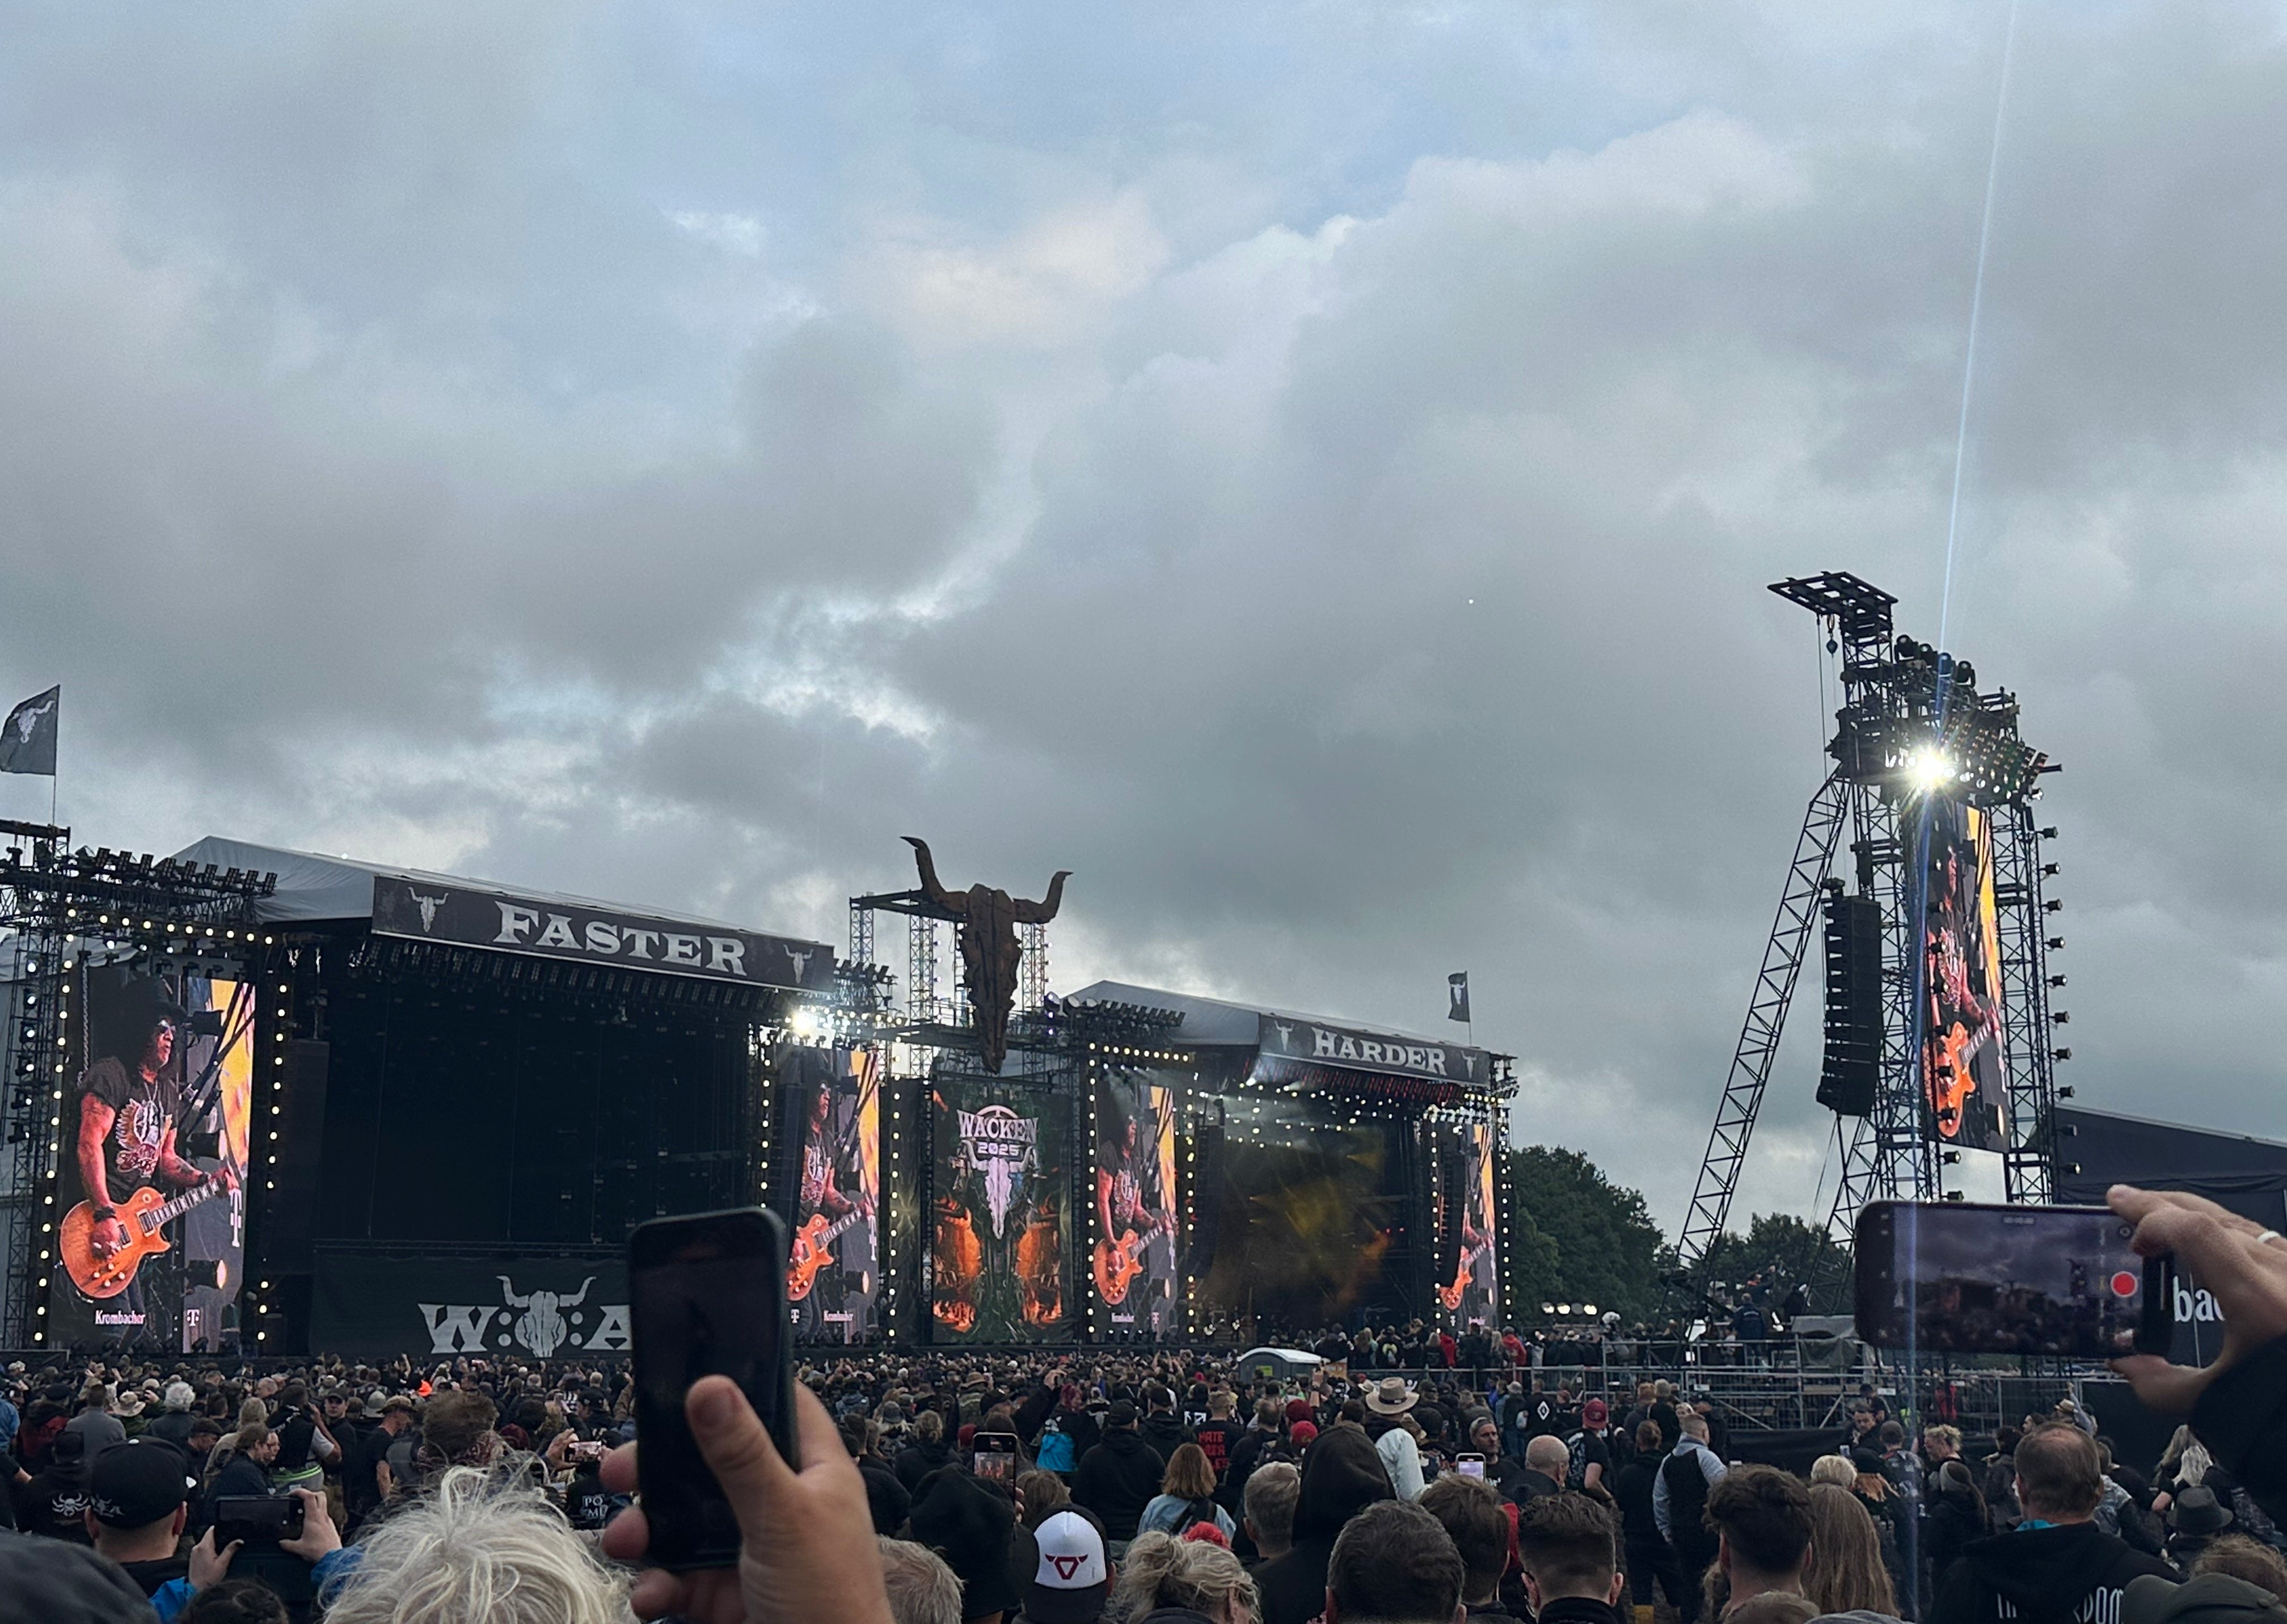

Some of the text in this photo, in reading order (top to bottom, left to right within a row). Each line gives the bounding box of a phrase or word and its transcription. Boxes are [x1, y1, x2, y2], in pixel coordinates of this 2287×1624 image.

[493, 901, 747, 977] FASTER
[1311, 1027, 1448, 1075] HARDER
[956, 1109, 1039, 1144] WACKEN
[977, 1141, 1022, 1157] 2025
[187, 1309, 200, 1327] T
